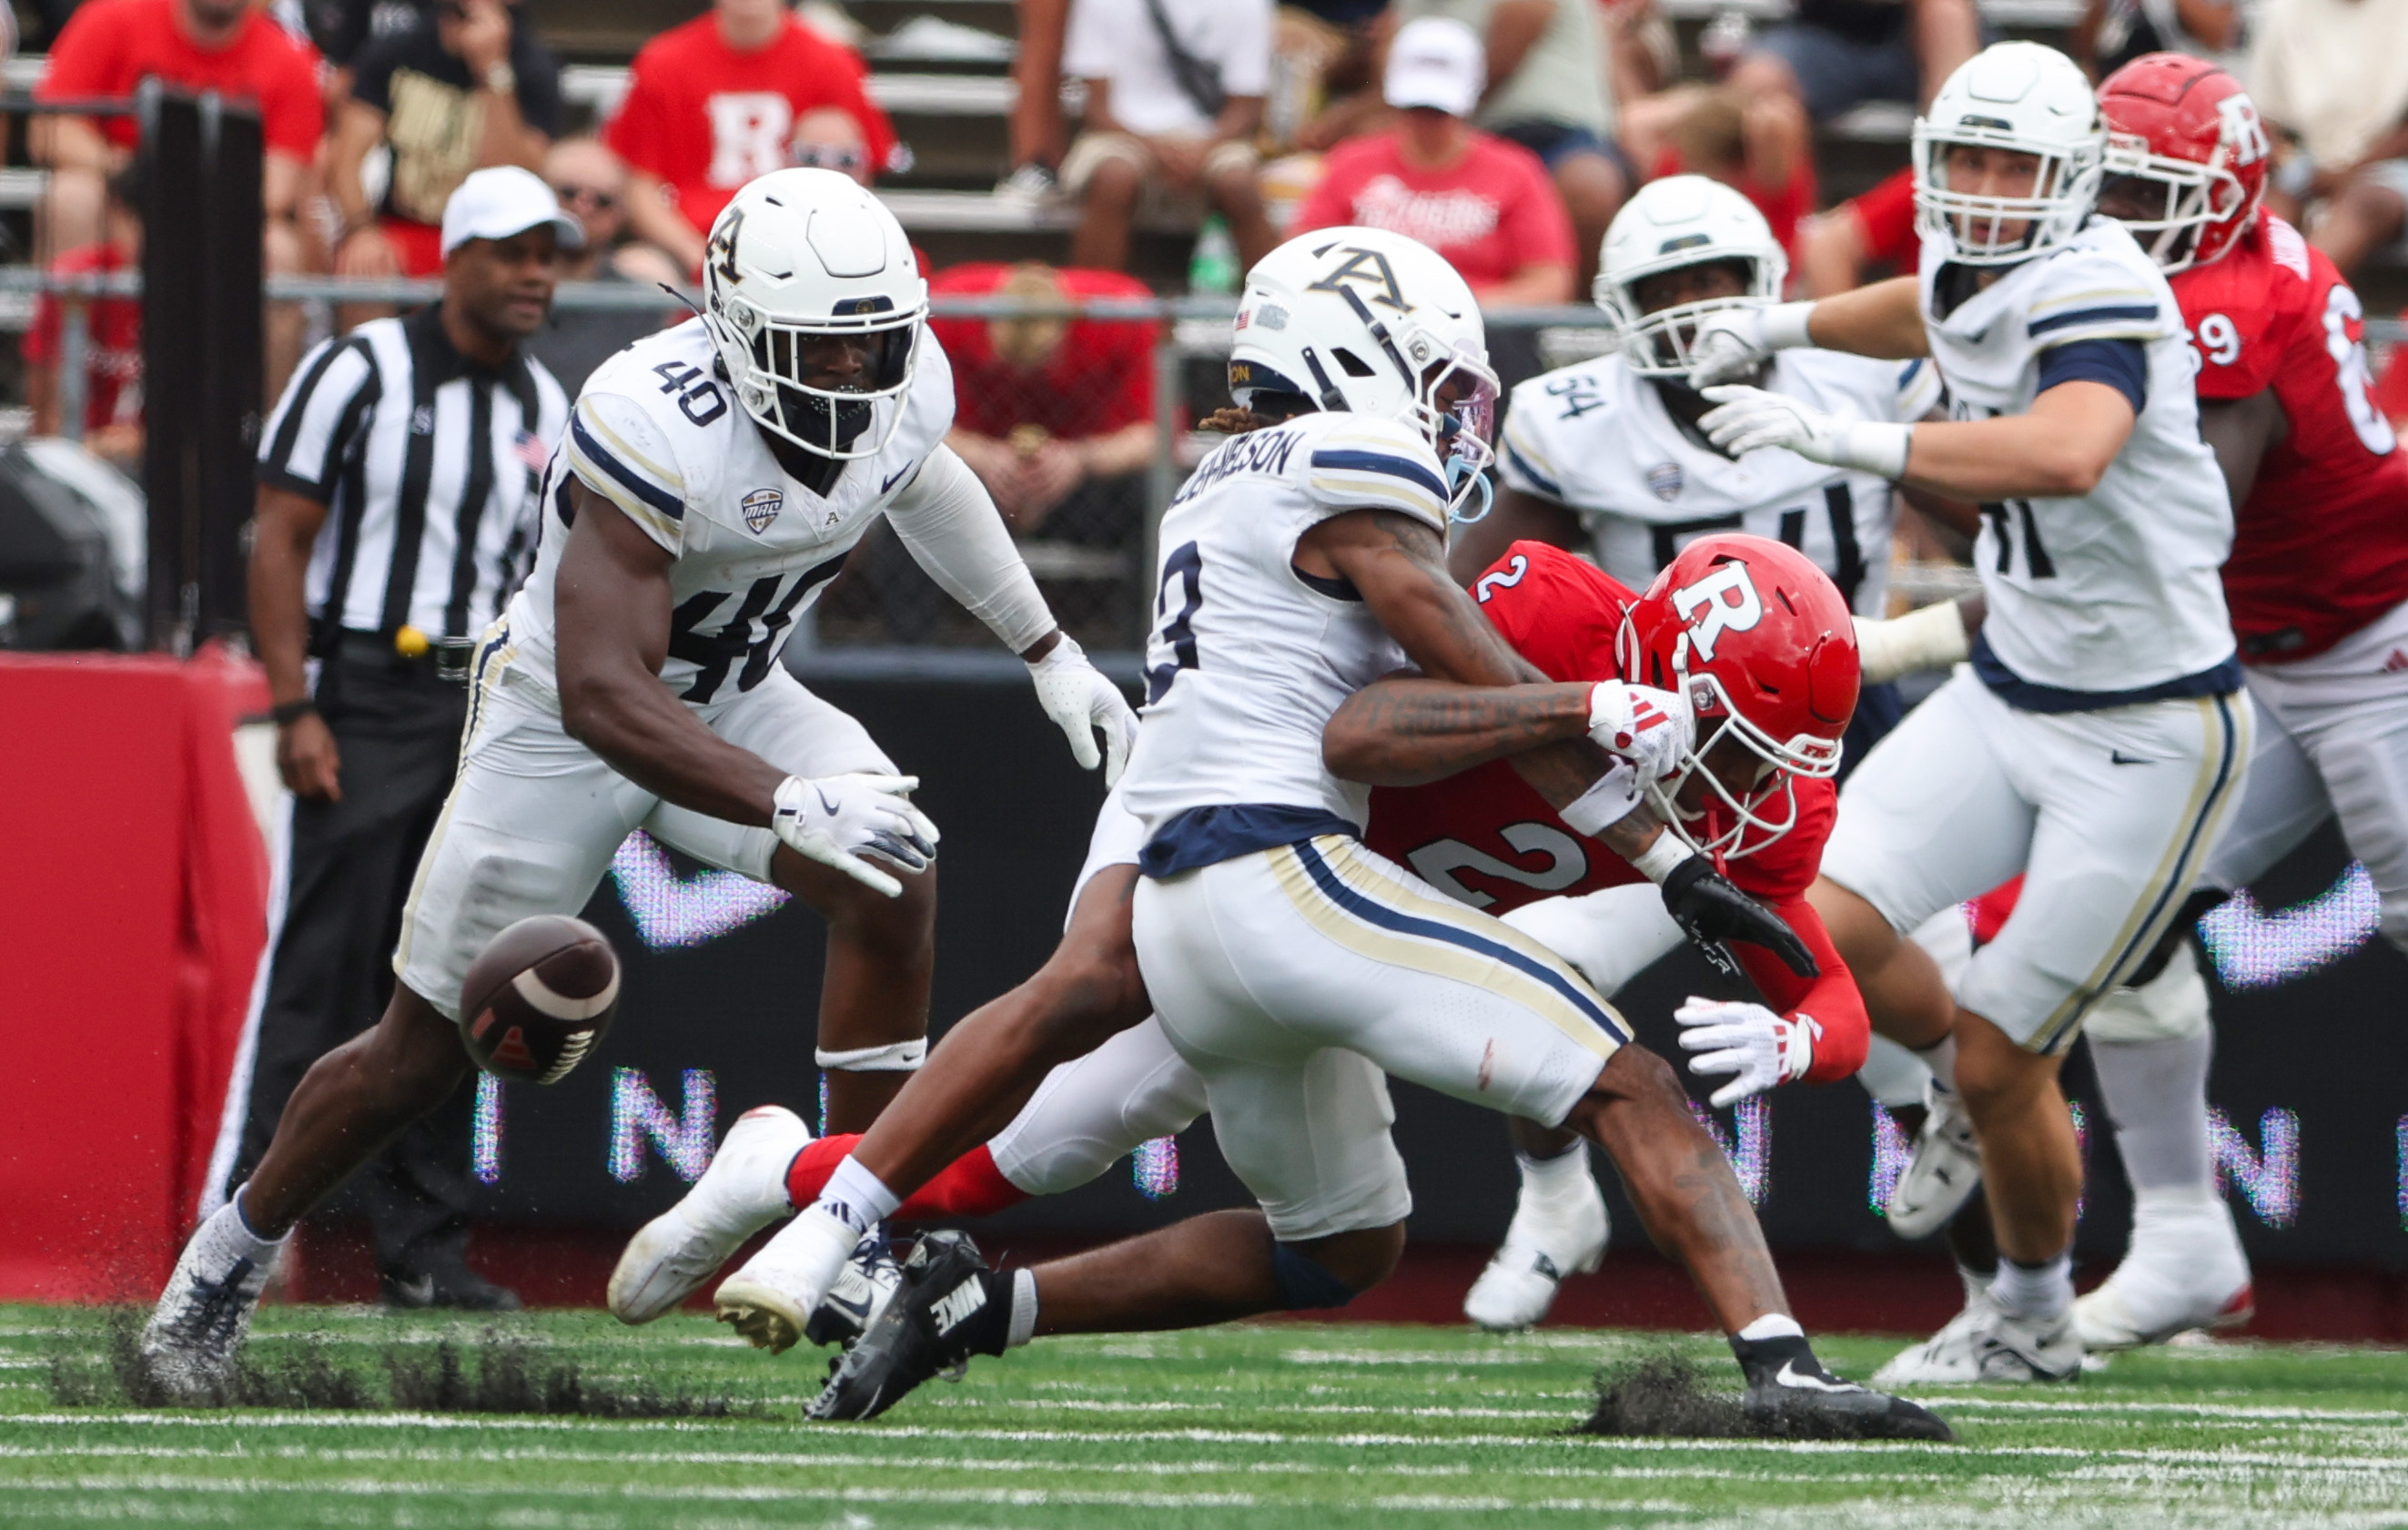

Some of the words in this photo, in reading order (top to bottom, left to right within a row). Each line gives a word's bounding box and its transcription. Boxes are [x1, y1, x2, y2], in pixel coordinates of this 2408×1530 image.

[704, 92, 791, 190] R
[2217, 93, 2270, 167] R
[651, 360, 728, 428] 40
[1545, 374, 1605, 420] 54
[744, 502, 782, 519] MAC
[825, 511, 841, 525] A
[1475, 552, 1530, 604] 2
[1671, 559, 1764, 664] R
[1405, 821, 1589, 911] 2
[928, 1272, 987, 1338] NIKE
